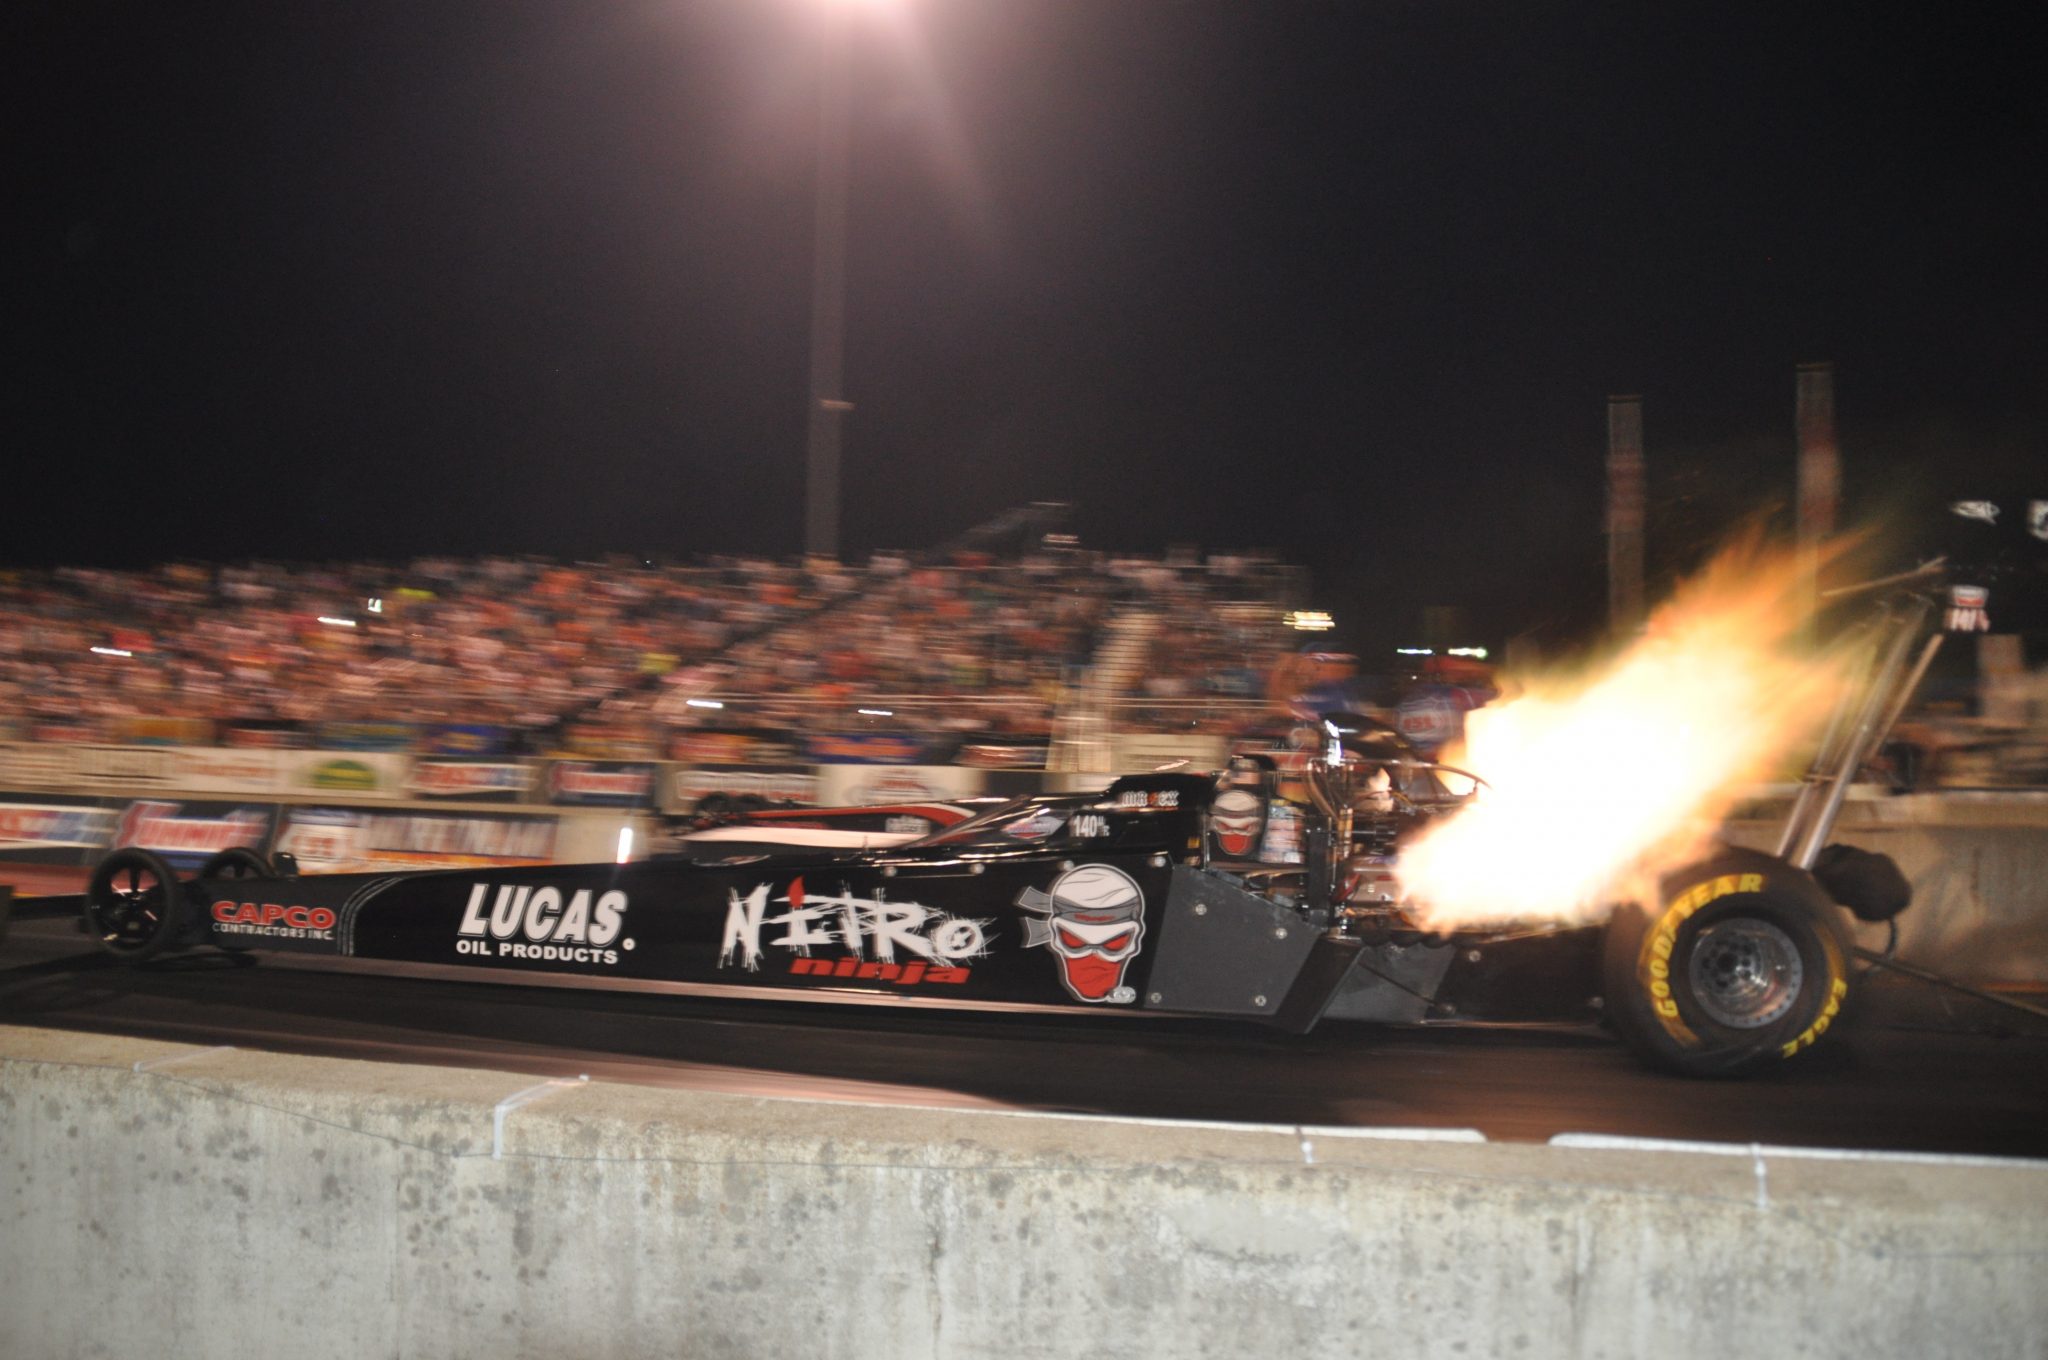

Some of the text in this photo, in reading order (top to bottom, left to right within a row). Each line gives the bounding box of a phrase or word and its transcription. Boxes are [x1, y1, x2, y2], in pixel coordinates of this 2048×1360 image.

[1073, 815, 1098, 837] 140
[211, 900, 336, 930] CAPCO
[457, 883, 628, 947] LUCAS
[212, 923, 306, 938] CONTRACTORS
[456, 939, 618, 964] OIL PRODUCTS
[1650, 873, 1763, 1018] GOODYEAR
[789, 957, 970, 985] ninja
[1782, 977, 1848, 1058] EAGLE
